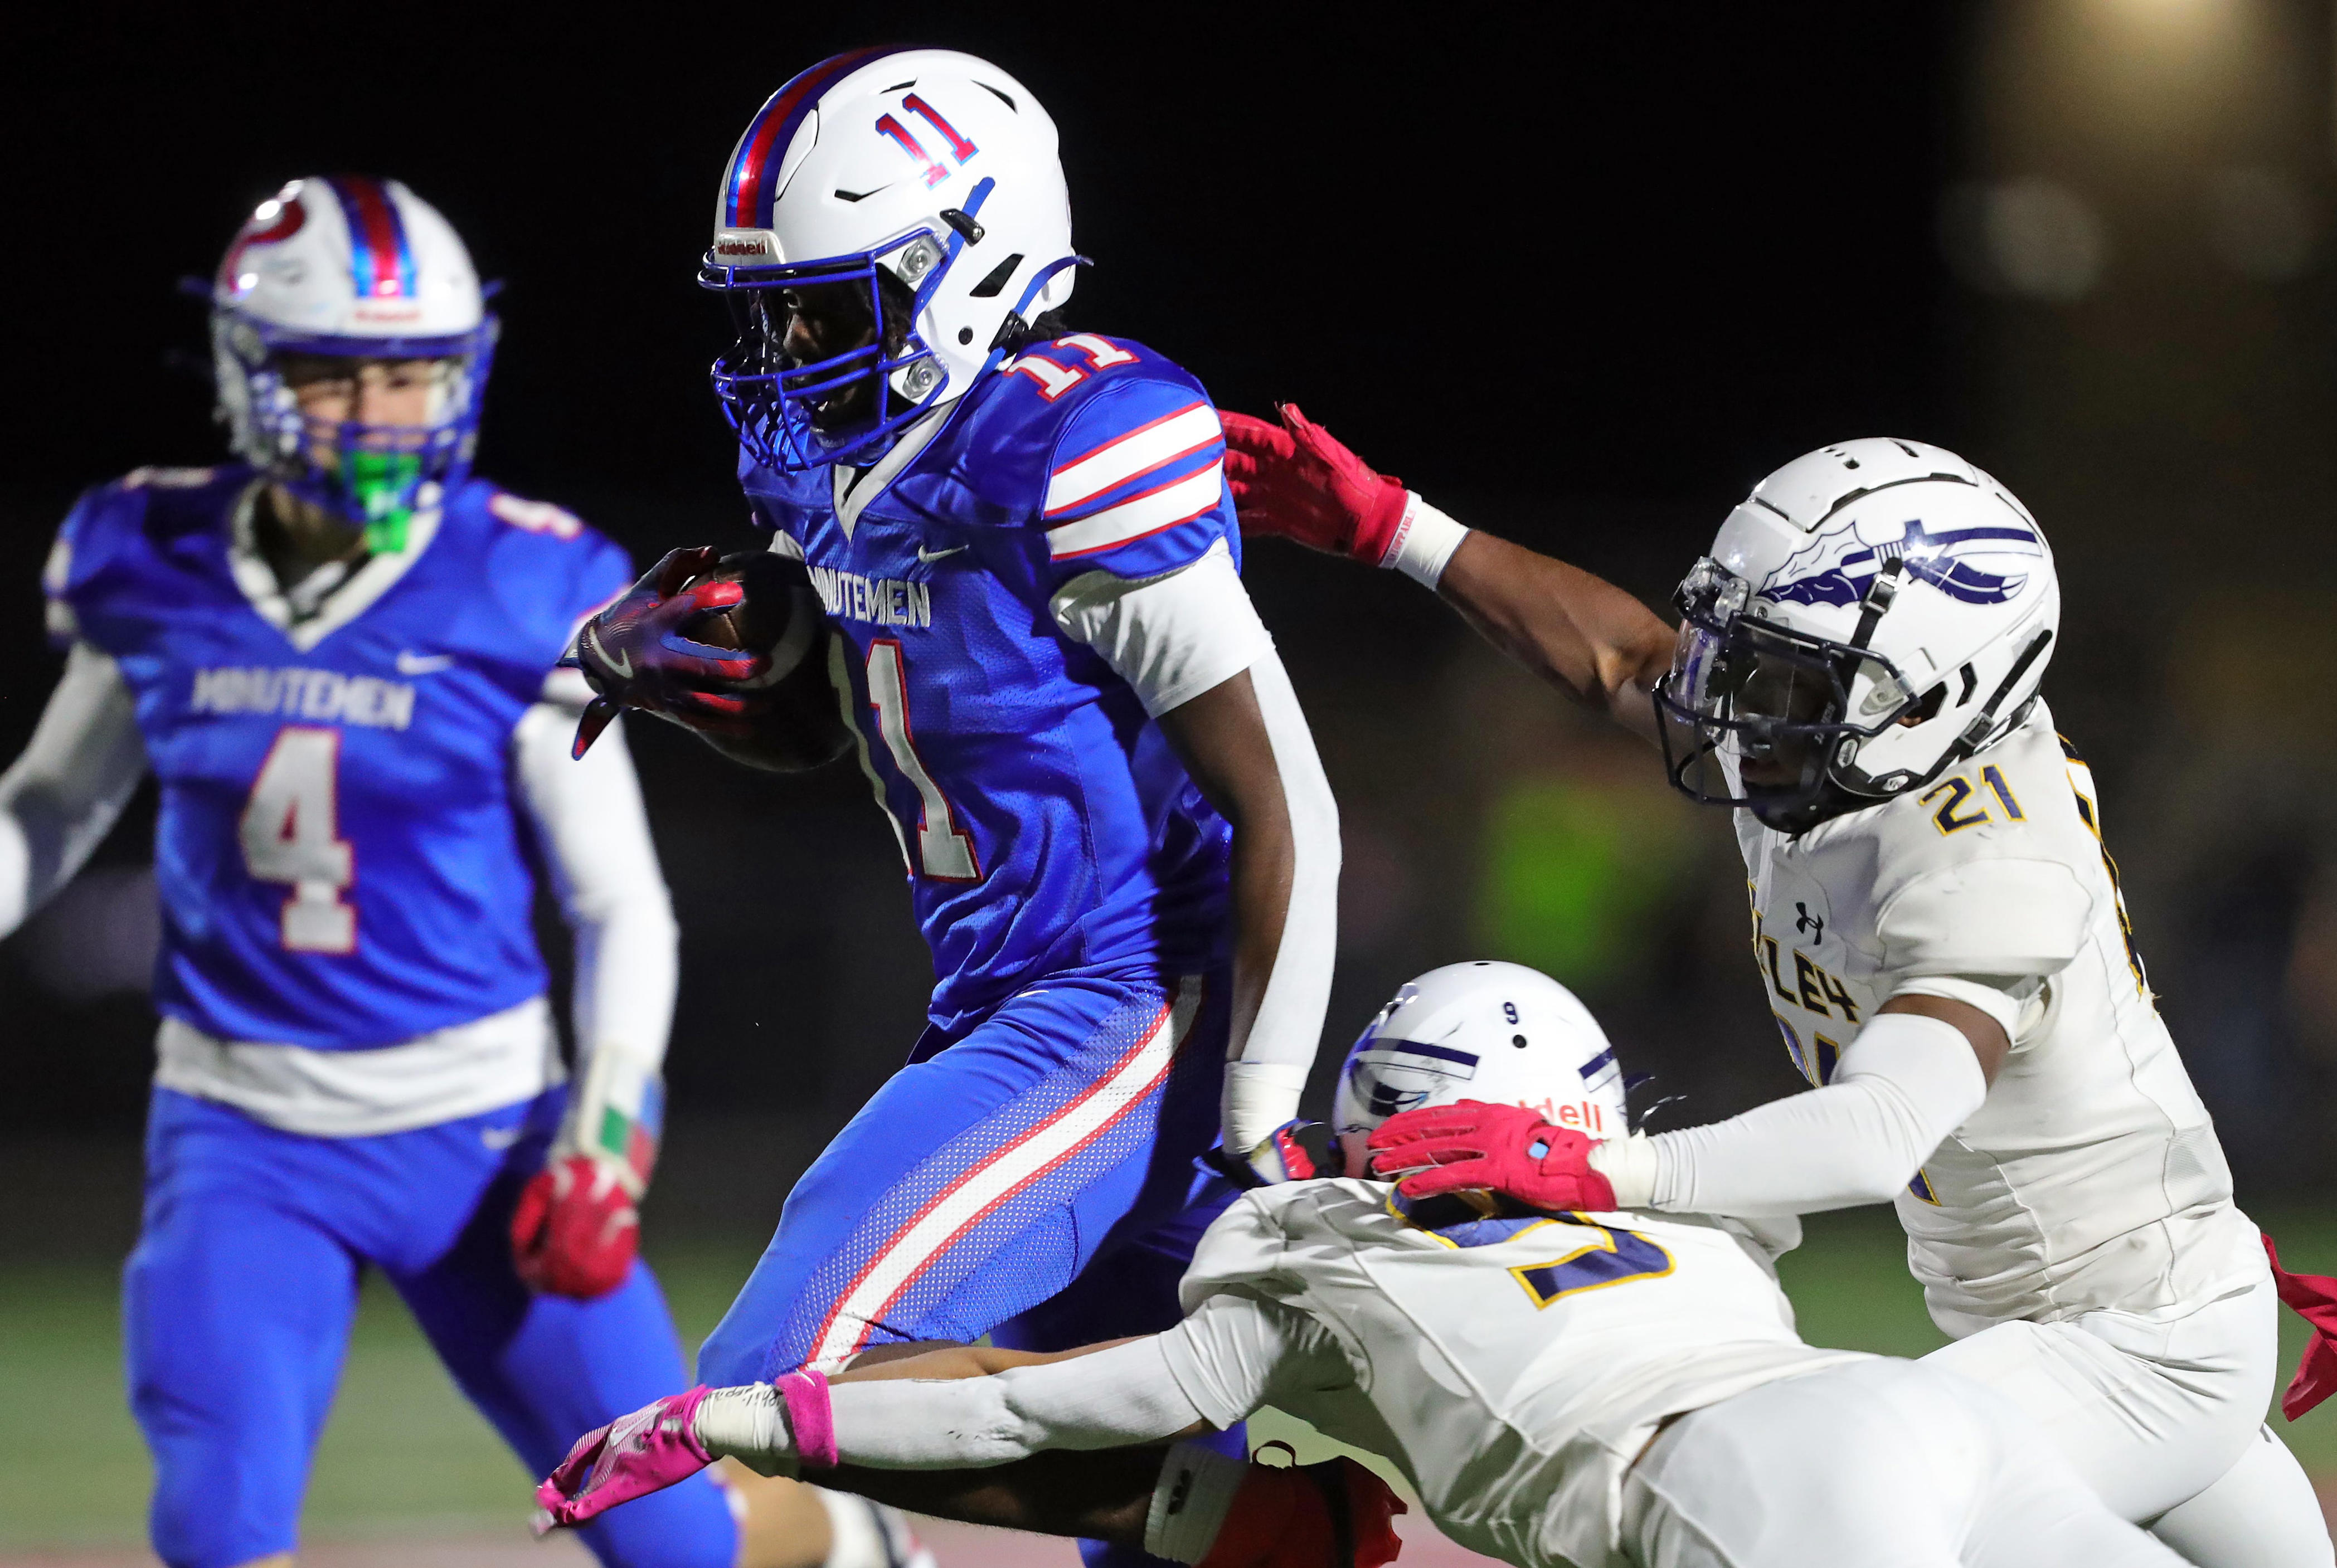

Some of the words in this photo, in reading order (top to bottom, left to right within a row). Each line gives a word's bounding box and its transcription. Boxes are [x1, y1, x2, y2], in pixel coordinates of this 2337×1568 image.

[876, 92, 979, 190] 11
[1004, 333, 1140, 402] 11
[191, 667, 415, 731] MINUTEMEN
[1918, 763, 2027, 837] 21
[239, 725, 358, 954] 4
[1504, 1001, 1519, 1025] 9
